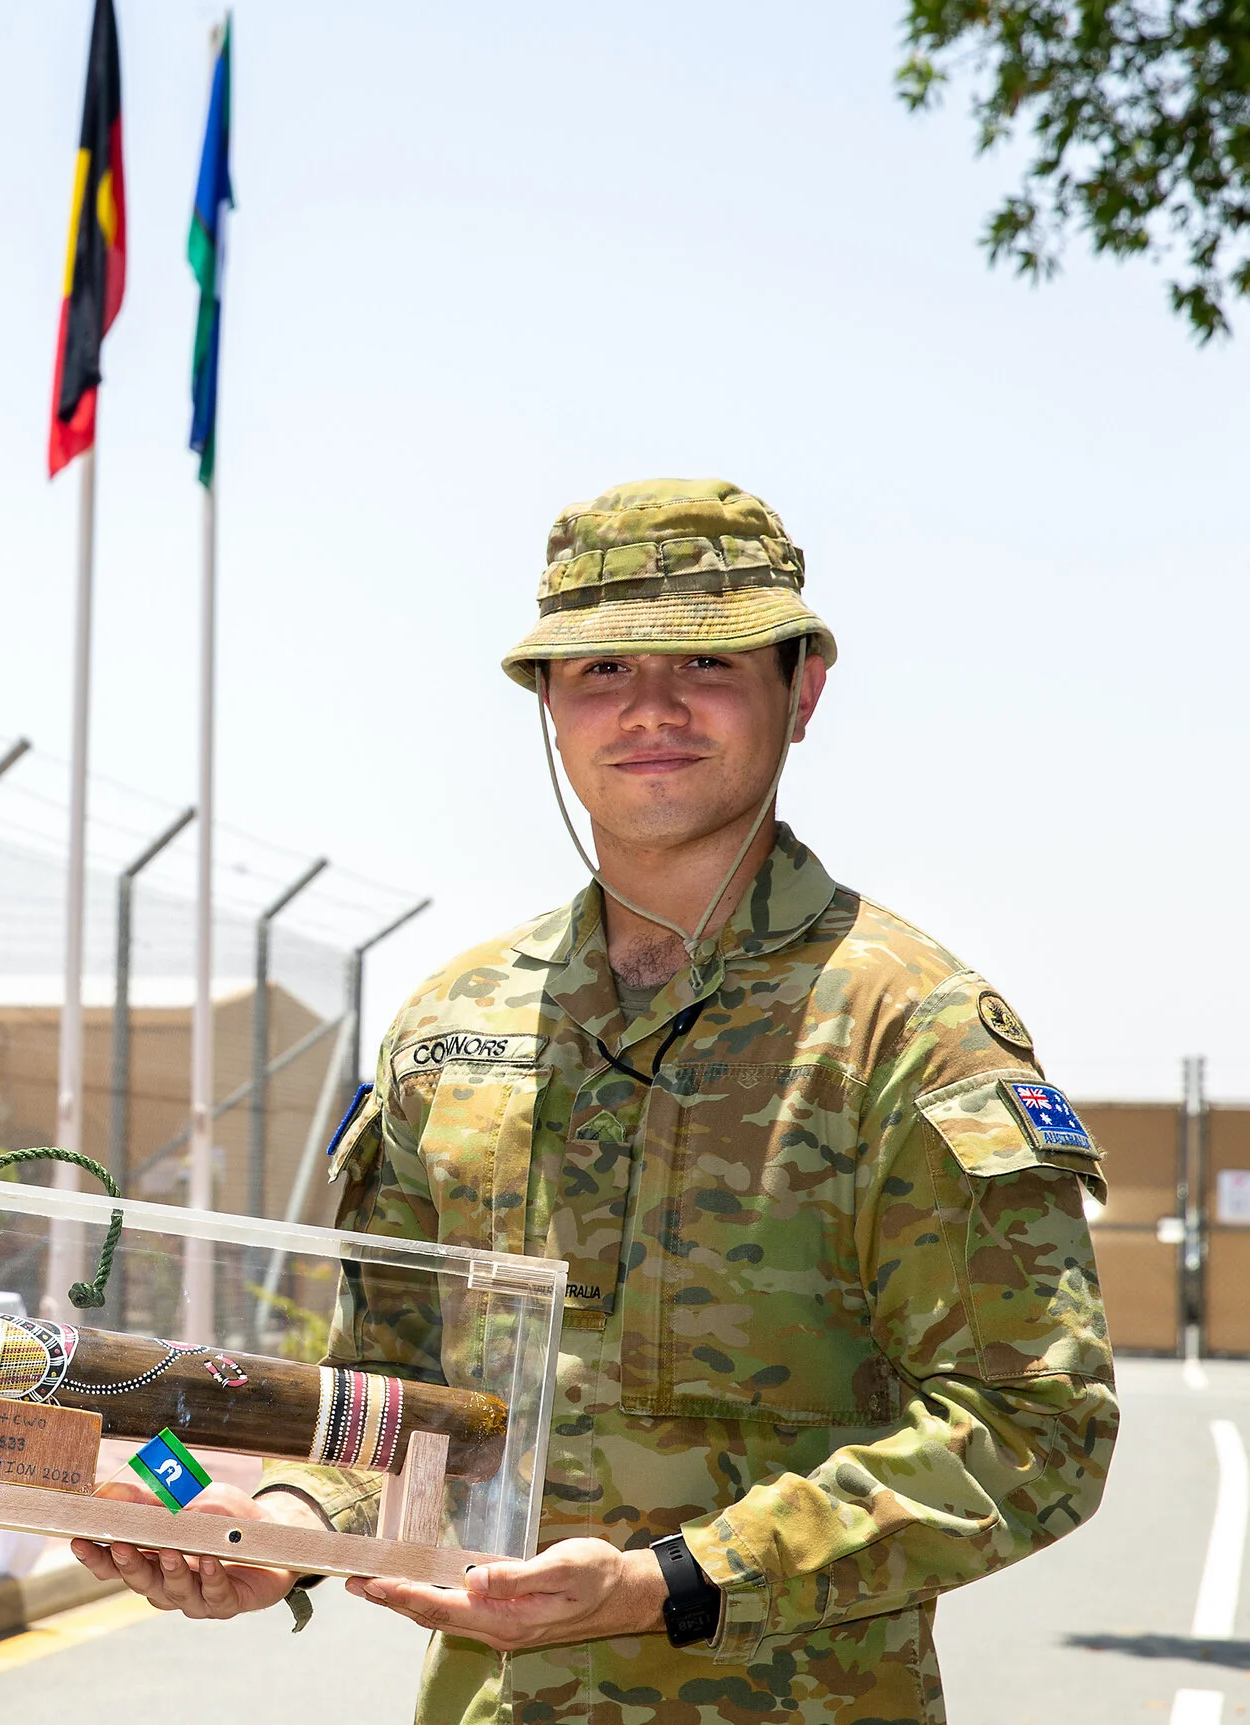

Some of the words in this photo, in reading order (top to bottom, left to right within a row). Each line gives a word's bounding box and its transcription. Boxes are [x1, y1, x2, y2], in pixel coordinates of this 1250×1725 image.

[413, 1035, 509, 1065] CONNORS
[1043, 1131, 1091, 1149] AUSTRALIA
[564, 1283, 601, 1299] TRALIA
[42, 1467, 82, 1484] 2020
